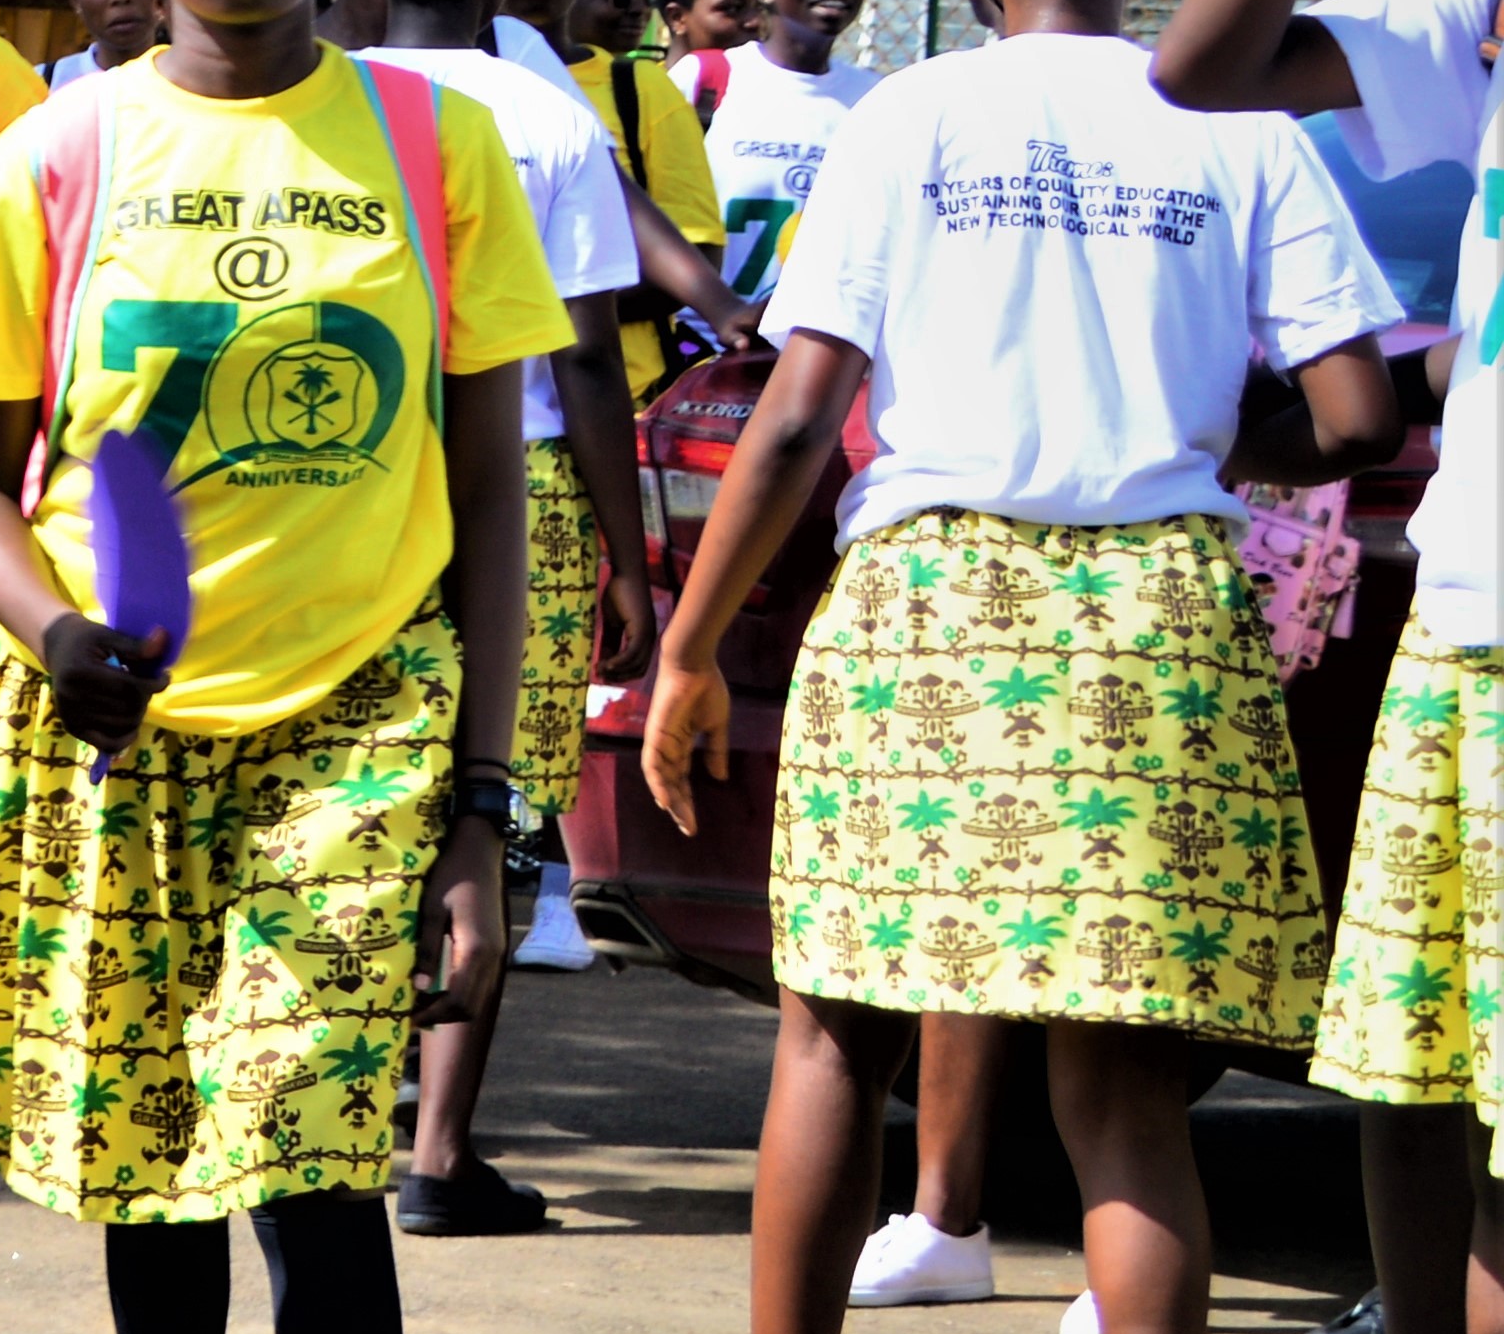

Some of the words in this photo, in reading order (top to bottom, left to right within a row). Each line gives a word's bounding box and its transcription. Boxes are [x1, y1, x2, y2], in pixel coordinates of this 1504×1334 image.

[733, 140, 800, 159] GREAT
[1026, 140, 1114, 179] Theme:
[116, 190, 246, 235] GREAT
[252, 188, 387, 239] APASS
[921, 183, 939, 199] 70
[943, 177, 1003, 194] YEARS
[1009, 177, 1033, 190] OF
[1036, 178, 1110, 199] QUALITY
[1115, 186, 1221, 214] EDUCATION:
[936, 194, 1043, 216] SUSTAINING
[1049, 198, 1080, 216] OUR
[1087, 204, 1141, 219] GAINS
[1149, 205, 1167, 222] IN
[1171, 209, 1205, 229] THE
[946, 214, 981, 234] NEW
[987, 212, 1130, 237] TECHNOLOGICAL
[1137, 223, 1196, 247] WORLD
[214, 236, 289, 301] @
[101, 298, 405, 482] 70
[671, 401, 753, 418] ACCORD
